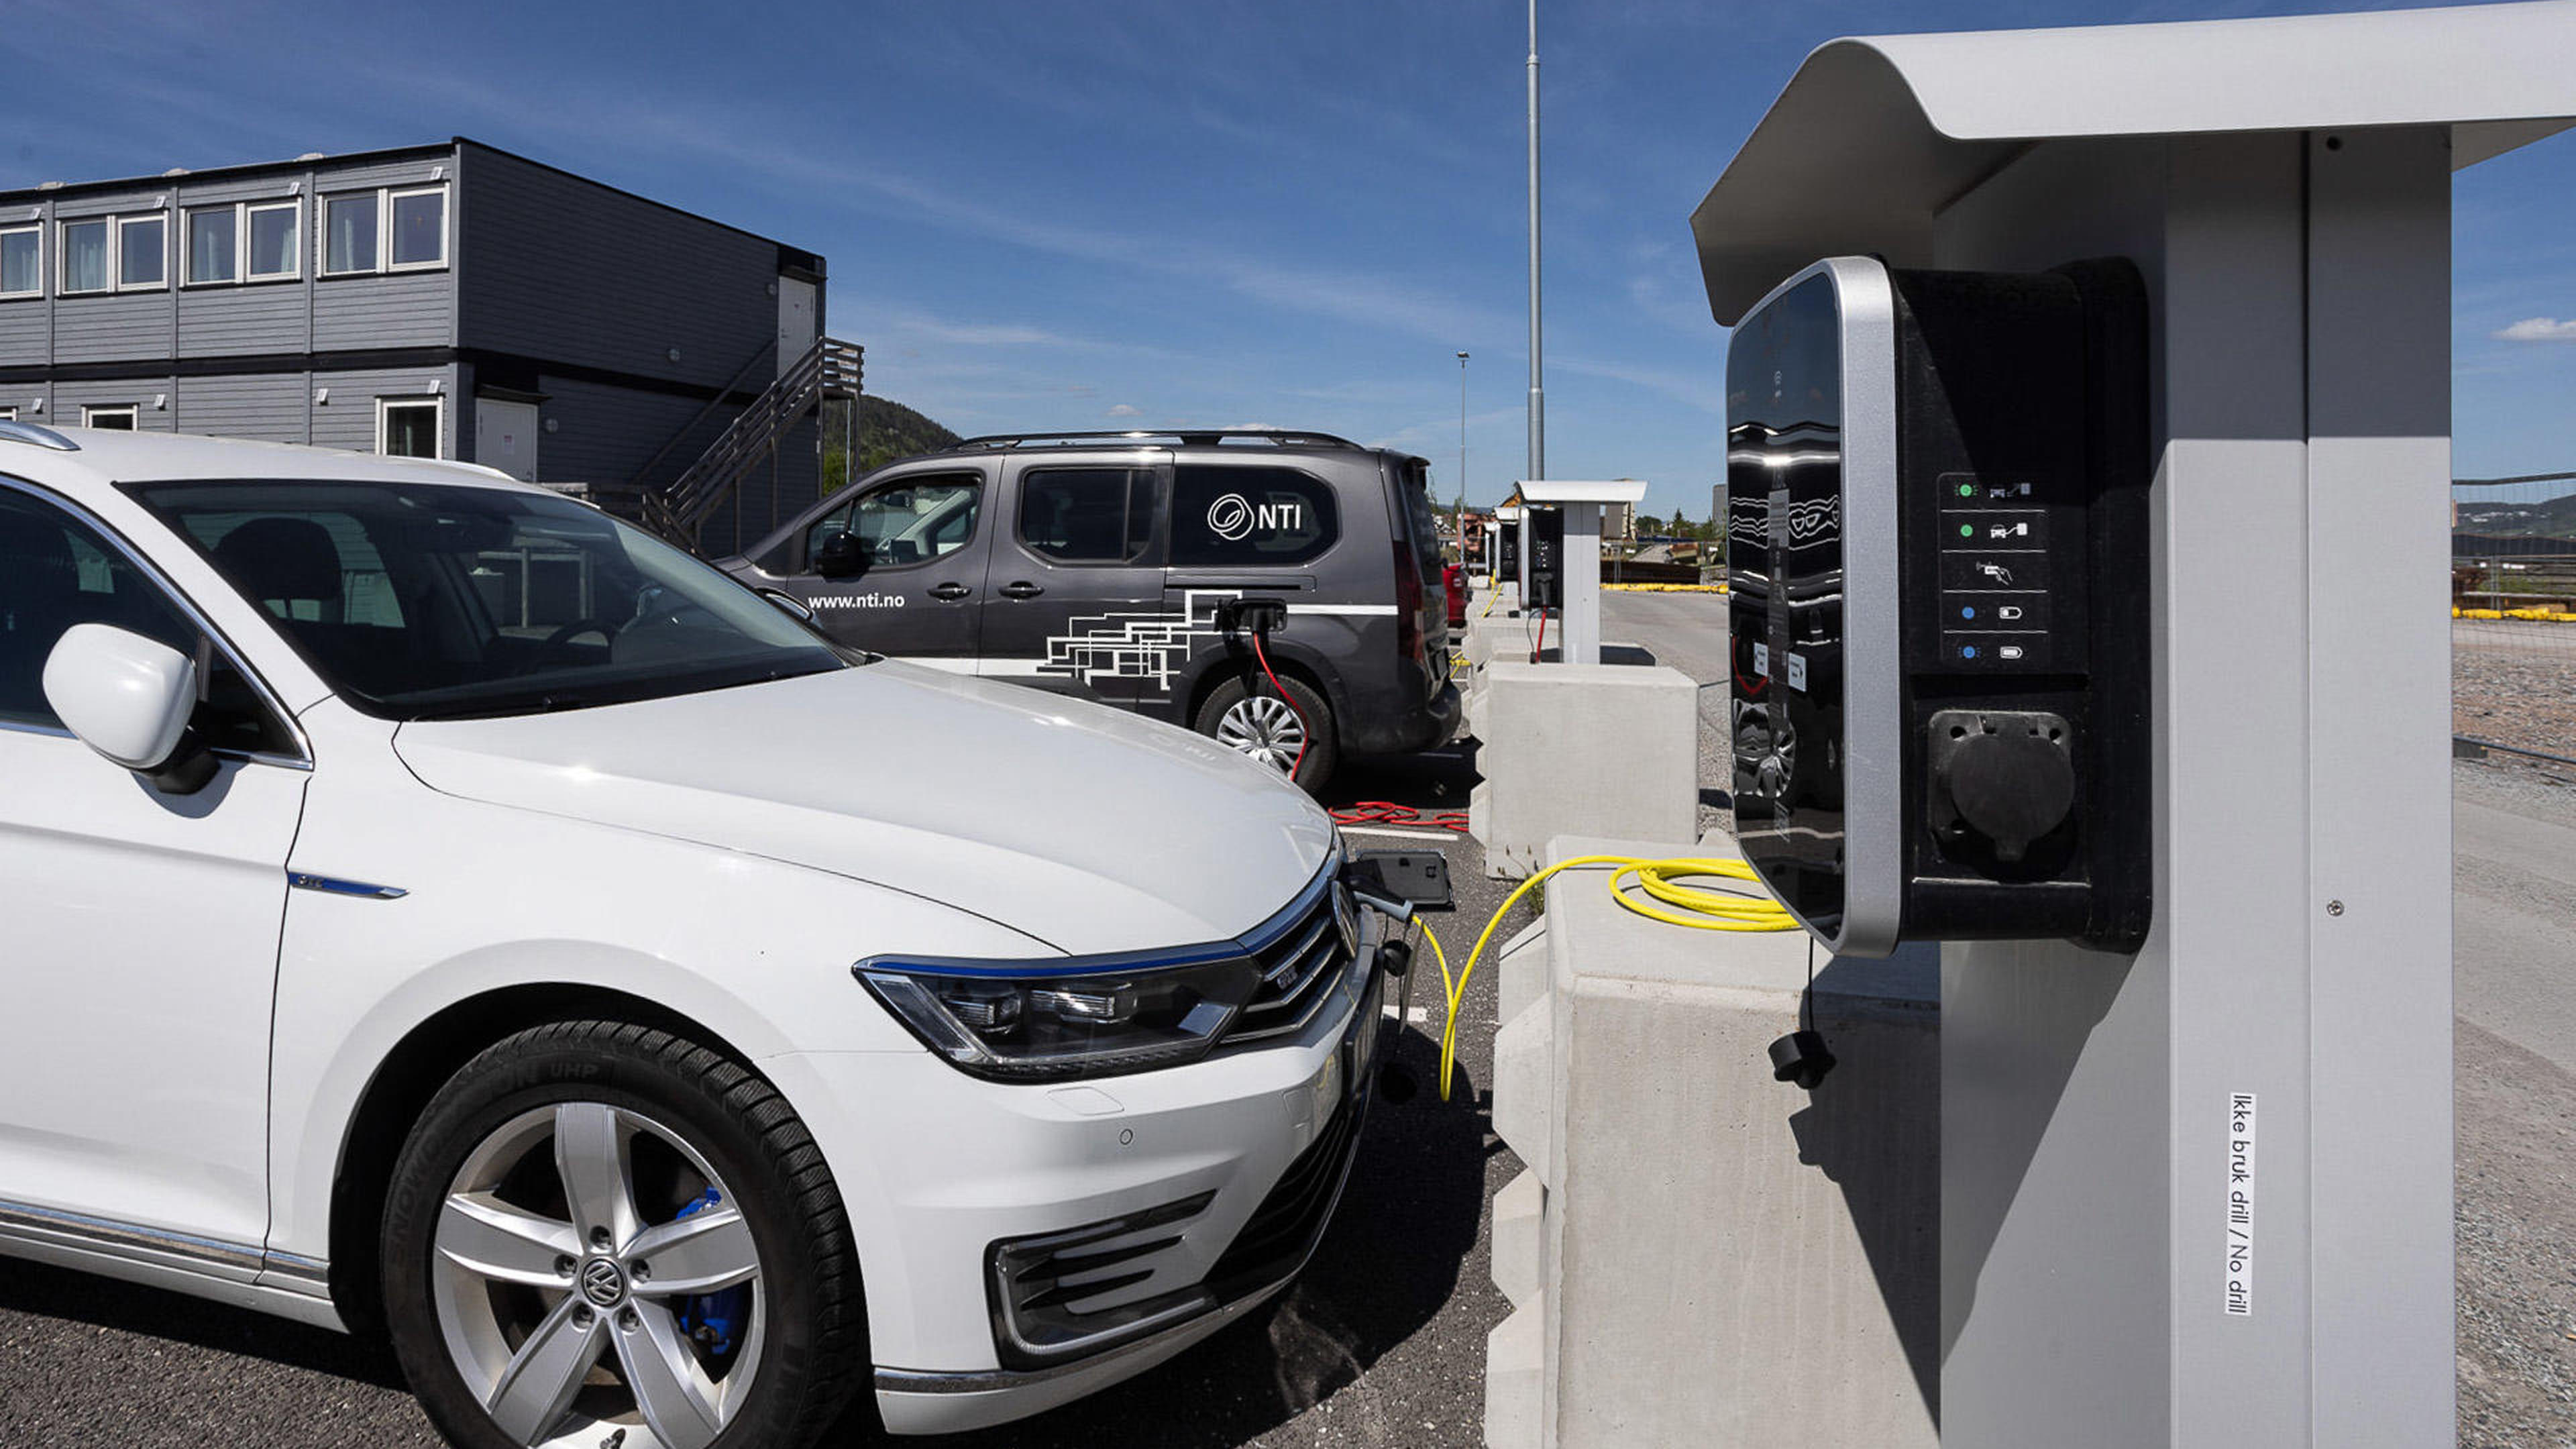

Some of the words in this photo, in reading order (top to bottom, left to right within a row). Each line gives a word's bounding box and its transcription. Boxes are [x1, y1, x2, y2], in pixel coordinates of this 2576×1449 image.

[1258, 504, 1301, 529] NTI
[808, 592, 905, 608] www.nti.no
[550, 1063, 598, 1079] UHP
[2233, 1094, 2251, 1133] Ikke
[2231, 1140, 2251, 1183] bruk
[2231, 1191, 2249, 1224] drill
[2229, 1228, 2248, 1239] /
[2229, 1244, 2248, 1273] No
[2228, 1281, 2247, 1313] drill
